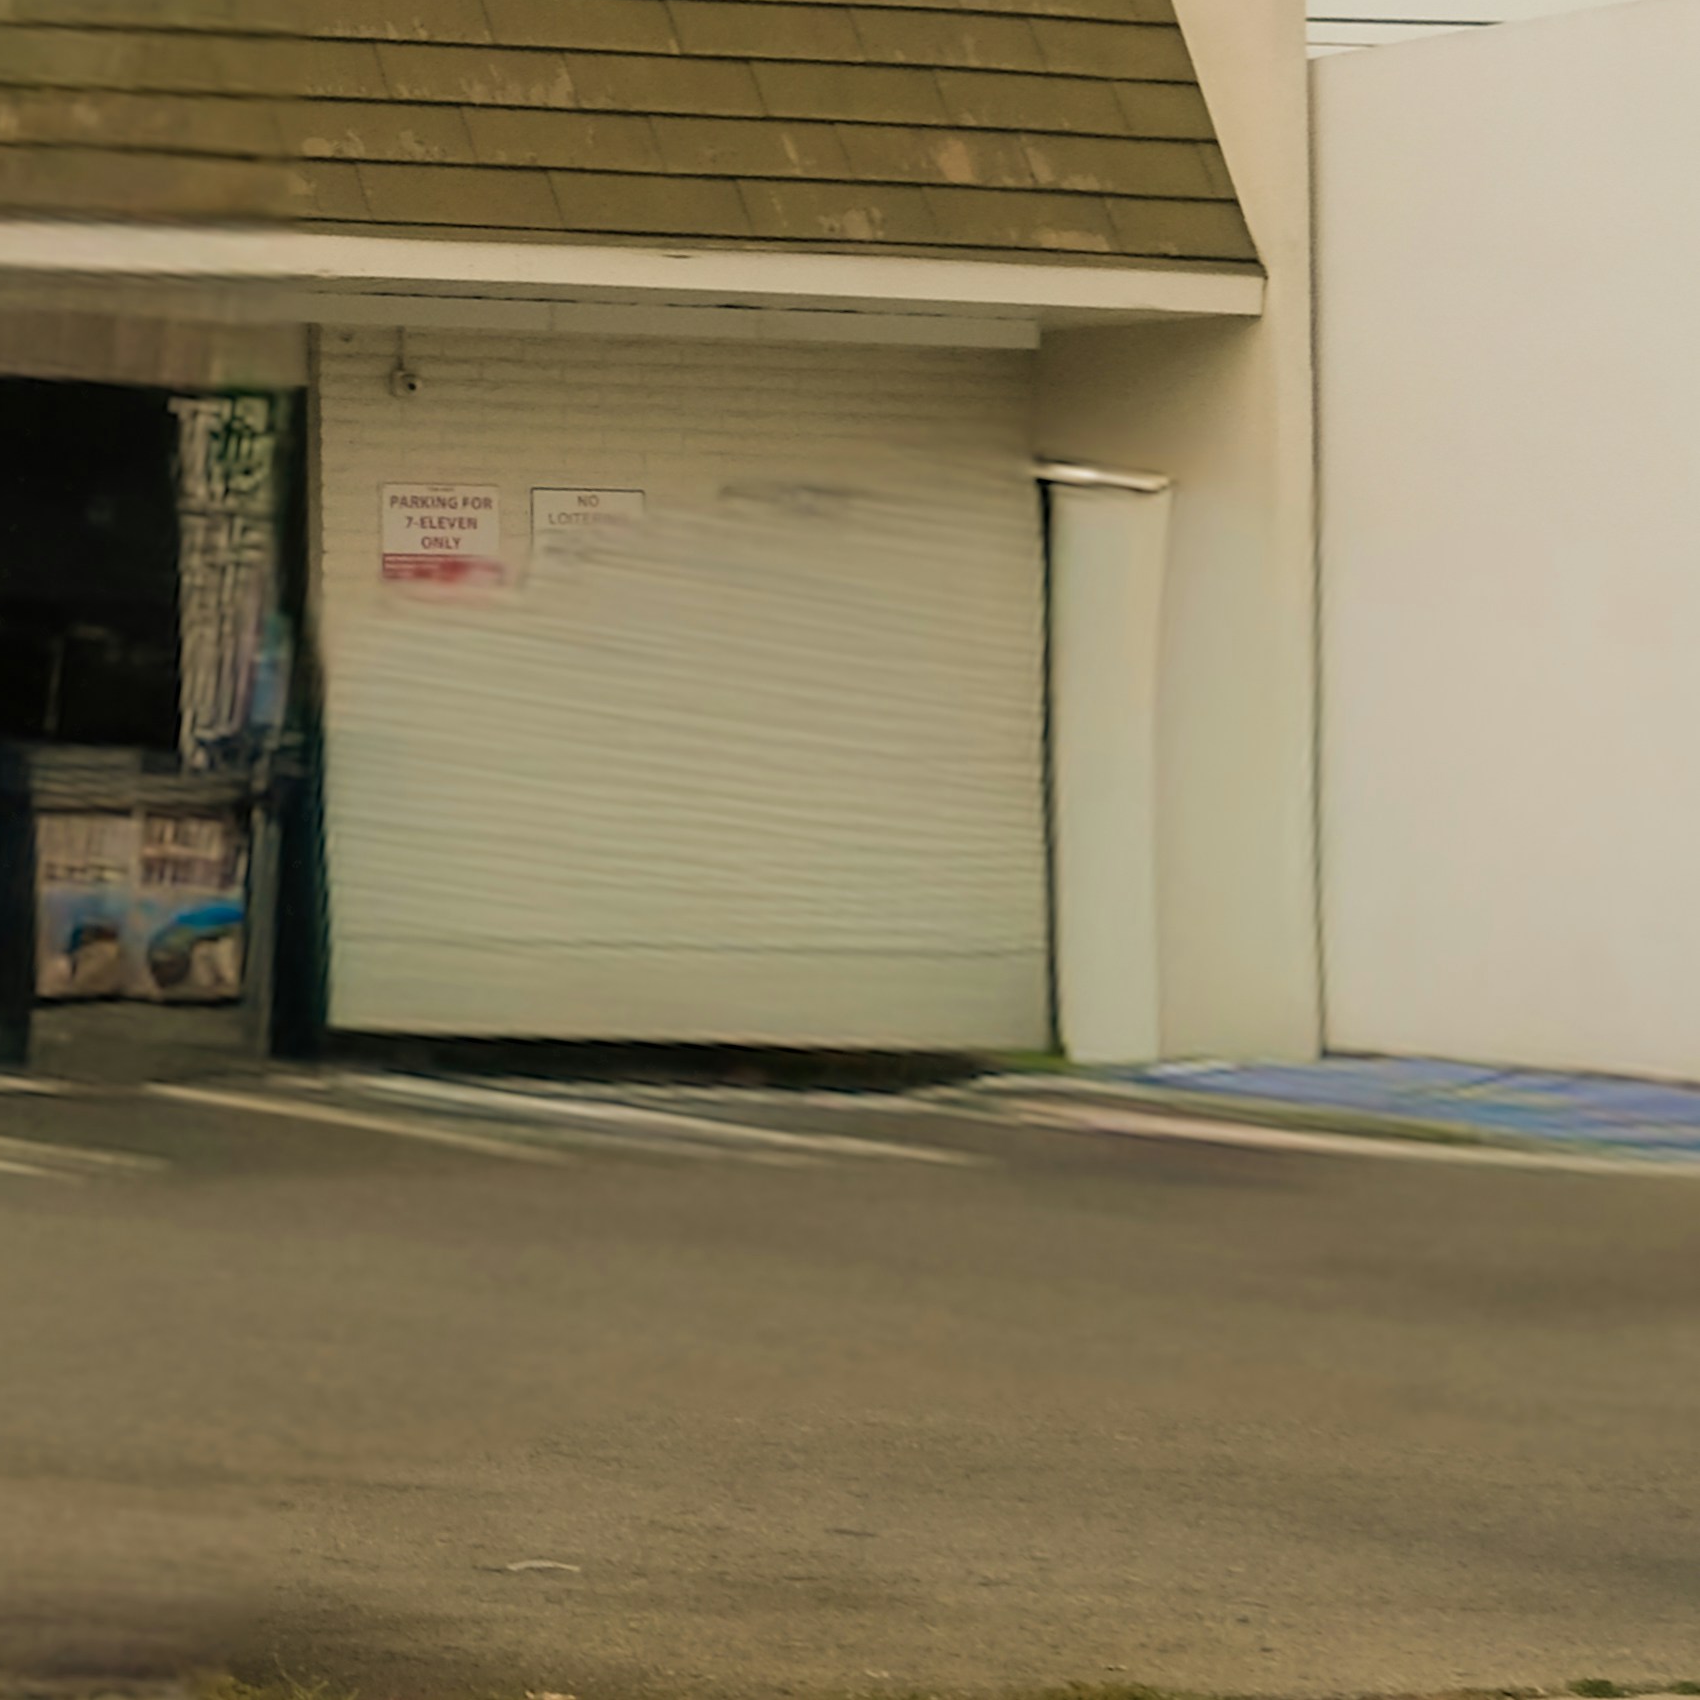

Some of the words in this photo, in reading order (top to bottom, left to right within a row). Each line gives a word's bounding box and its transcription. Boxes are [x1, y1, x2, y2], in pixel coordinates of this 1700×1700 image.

[390, 495, 459, 510] PARKING
[462, 496, 493, 510] FOR
[577, 495, 599, 507] NO
[405, 515, 478, 530] 7-ELEVEN
[420, 536, 461, 549] ONLY
